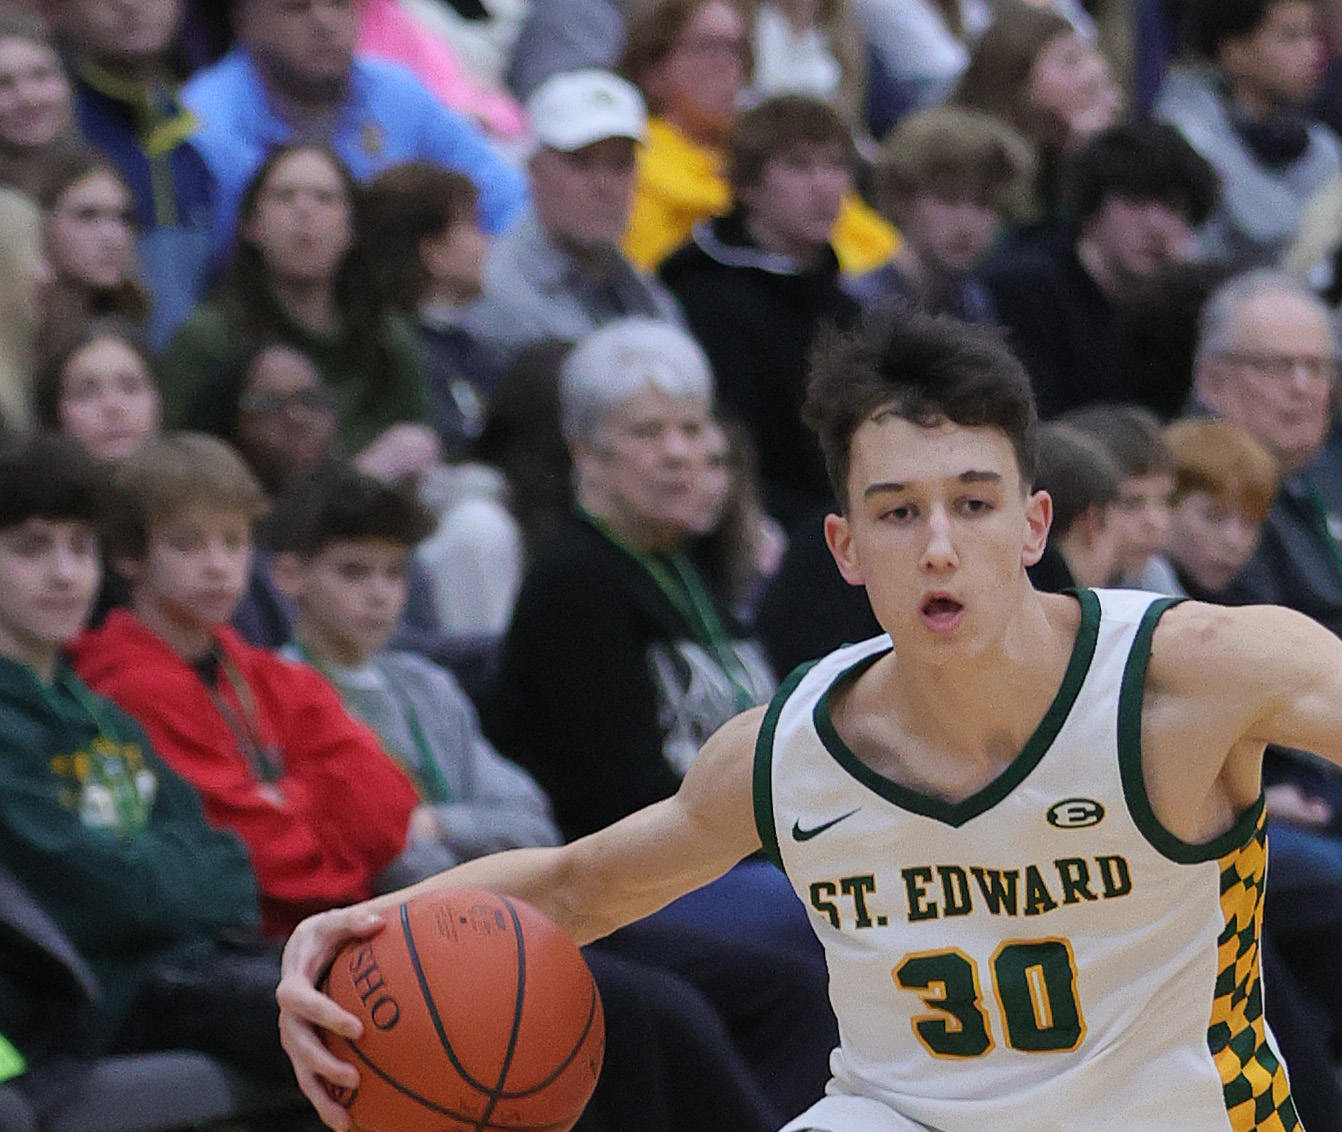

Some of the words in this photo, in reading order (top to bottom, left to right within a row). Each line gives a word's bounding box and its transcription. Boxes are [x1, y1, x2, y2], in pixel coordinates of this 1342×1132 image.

[809, 873, 889, 930] ST.
[901, 854, 1132, 922] EDWARD
[891, 936, 1086, 1060] 30
